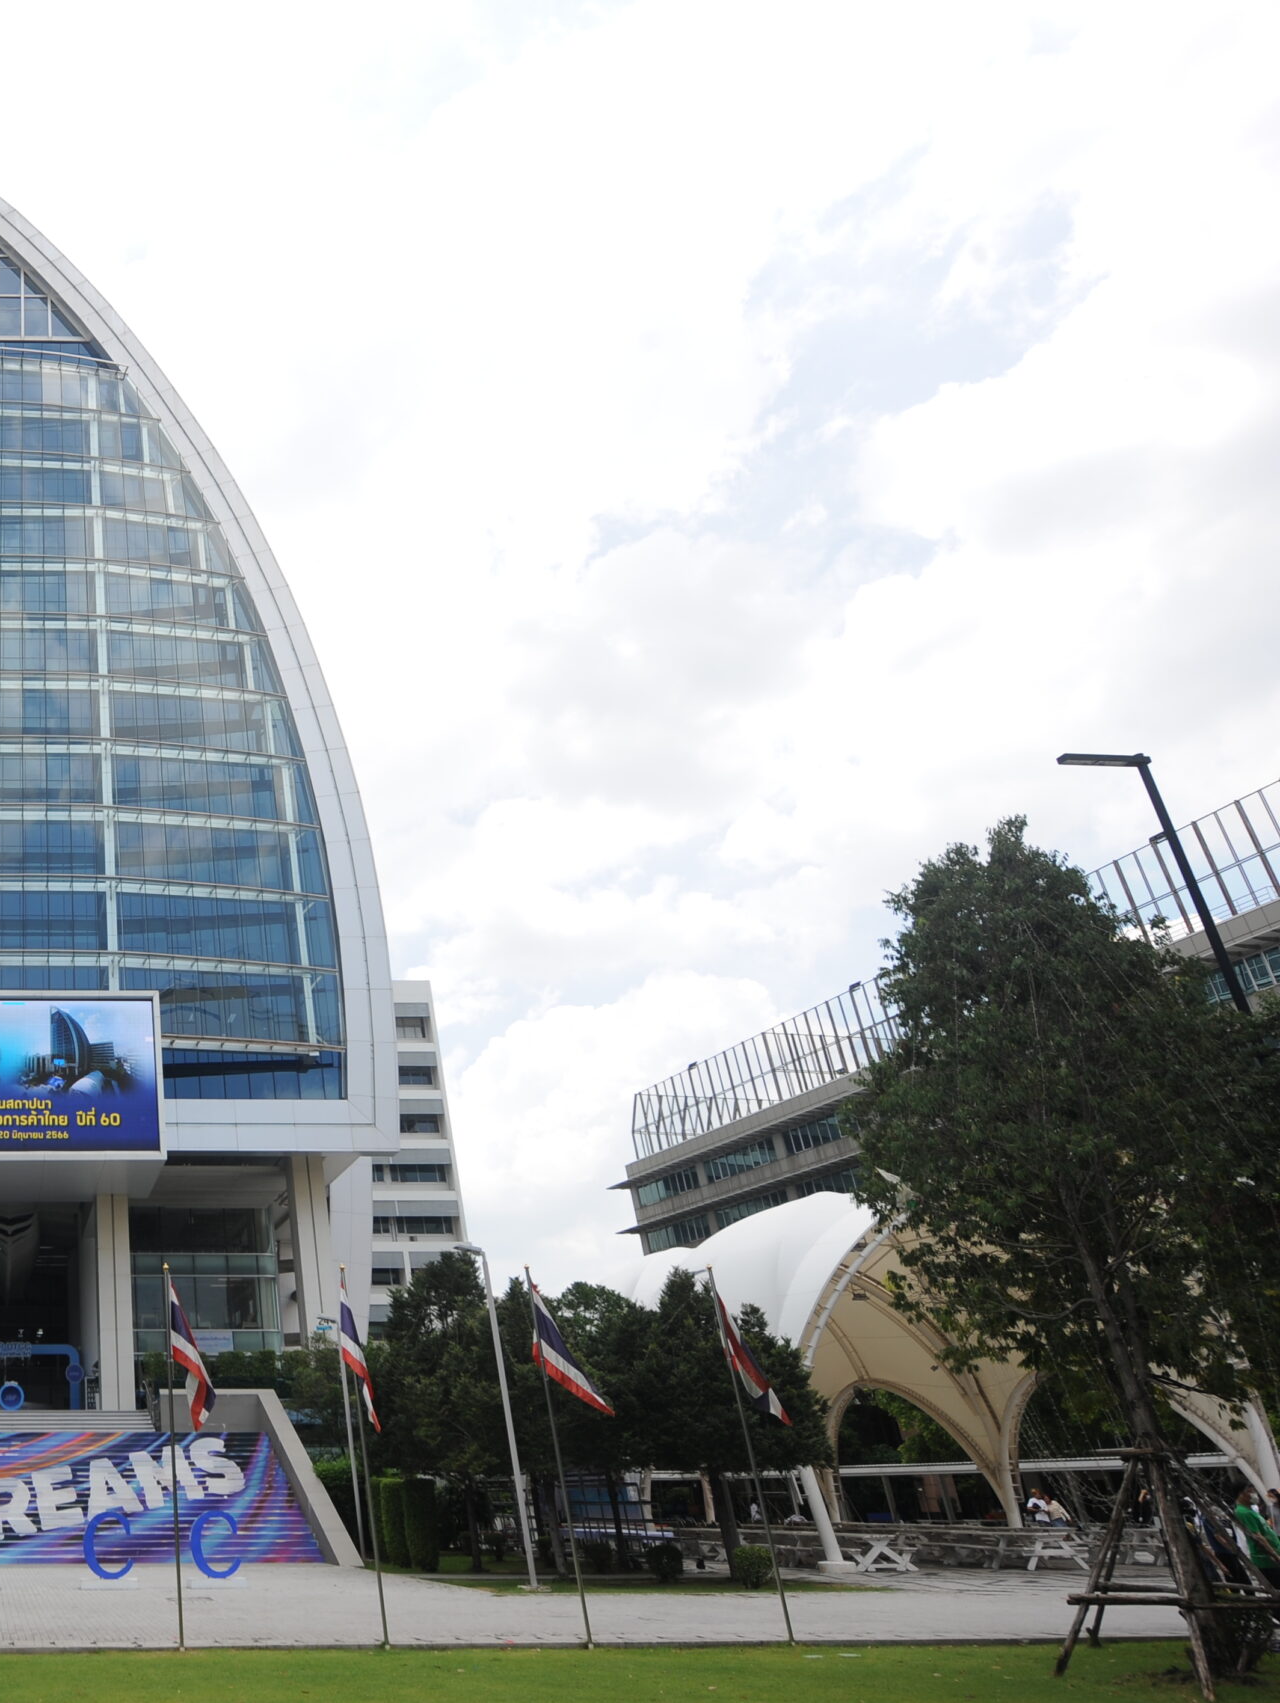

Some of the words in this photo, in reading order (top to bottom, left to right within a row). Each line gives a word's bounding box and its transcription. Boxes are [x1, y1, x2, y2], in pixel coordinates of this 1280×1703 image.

[76, 1107, 96, 1126] ปีที่
[100, 1112, 121, 1126] 60
[11, 1129, 44, 1141] มิถุนายน
[45, 1130, 69, 1139] 2566
